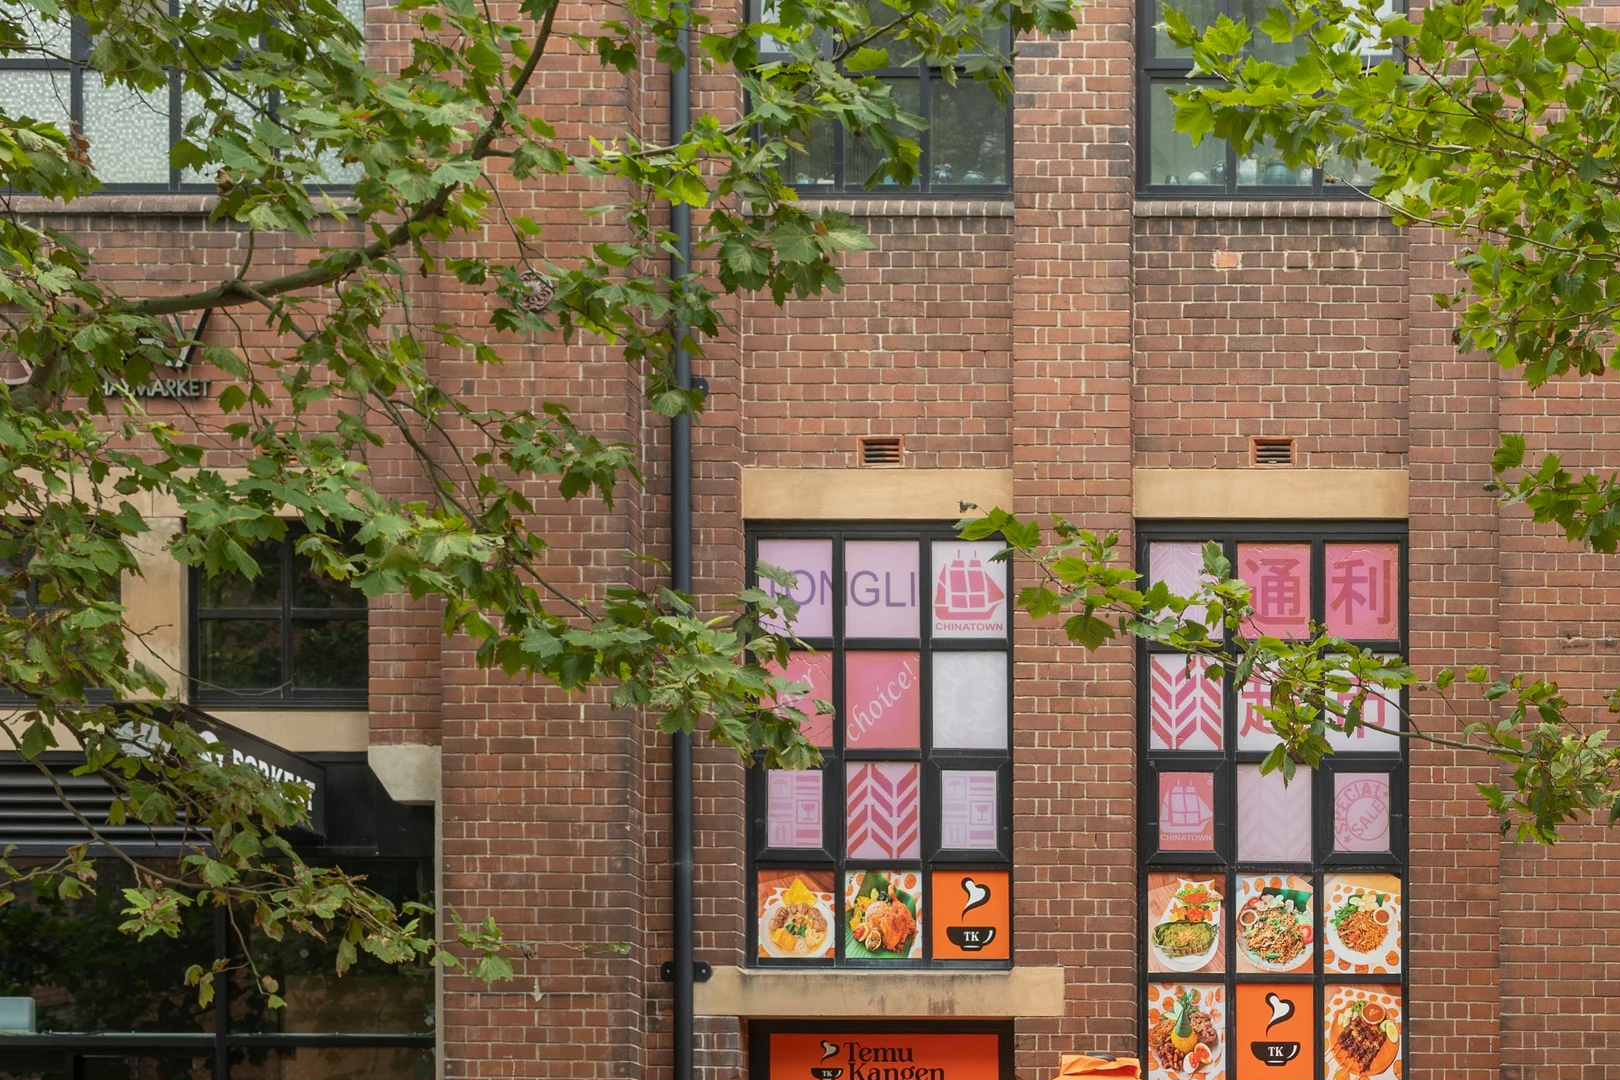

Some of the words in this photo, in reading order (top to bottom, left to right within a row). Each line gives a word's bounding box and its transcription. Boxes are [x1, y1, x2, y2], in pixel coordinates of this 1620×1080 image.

[935, 622, 1003, 631] CHINATOWN
[846, 660, 917, 742] choice!
[1336, 782, 1382, 834] SPECIAL
[1351, 799, 1385, 837] SALE
[1159, 834, 1212, 842] CHINATOWN
[964, 931, 980, 941] TK
[843, 1042, 914, 1062] Temu
[1267, 1046, 1284, 1057] TK
